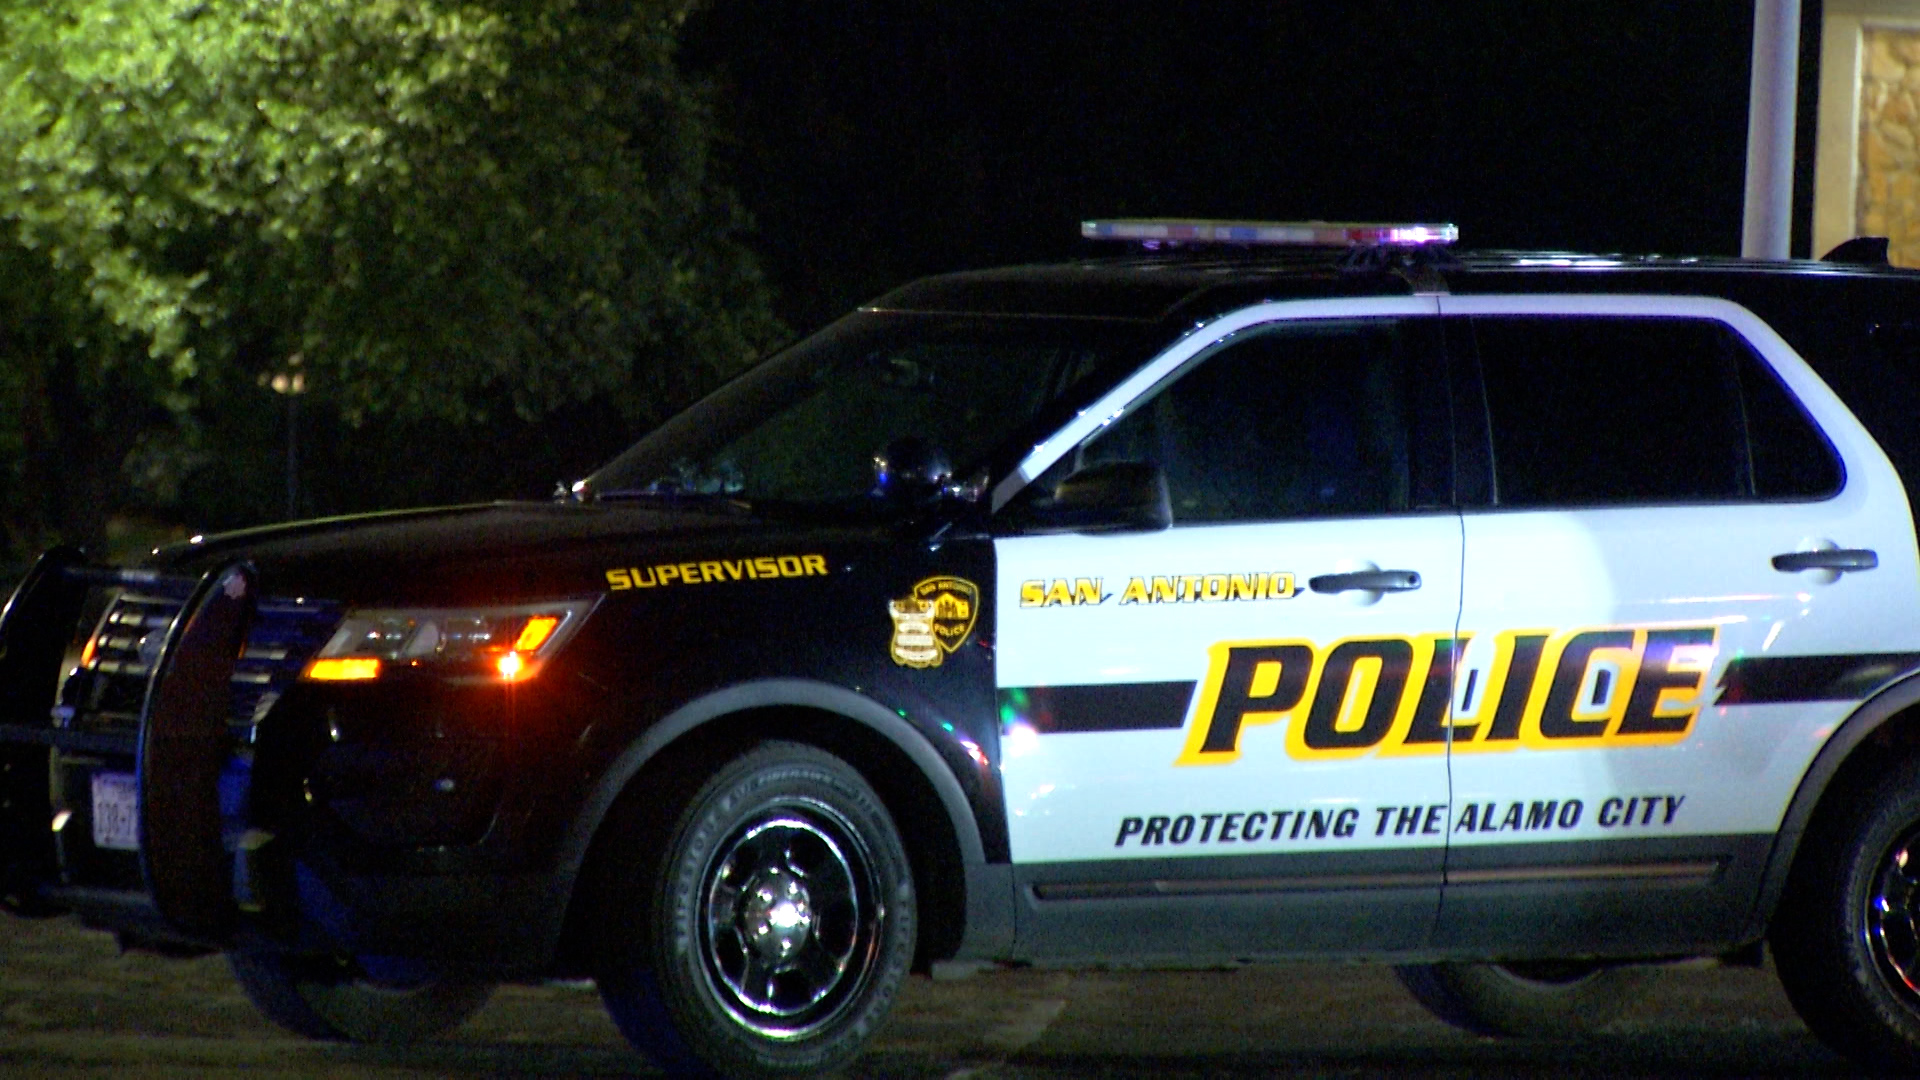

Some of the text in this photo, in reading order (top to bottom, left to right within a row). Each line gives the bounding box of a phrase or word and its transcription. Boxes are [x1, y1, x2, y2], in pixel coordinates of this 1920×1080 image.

[605, 554, 829, 590] SUPERVISOR
[1020, 571, 1301, 608] SAN ANTONIO
[1173, 625, 1720, 767] POLICE
[1114, 794, 1686, 847] PROTECTING THE ALAMO CITY
